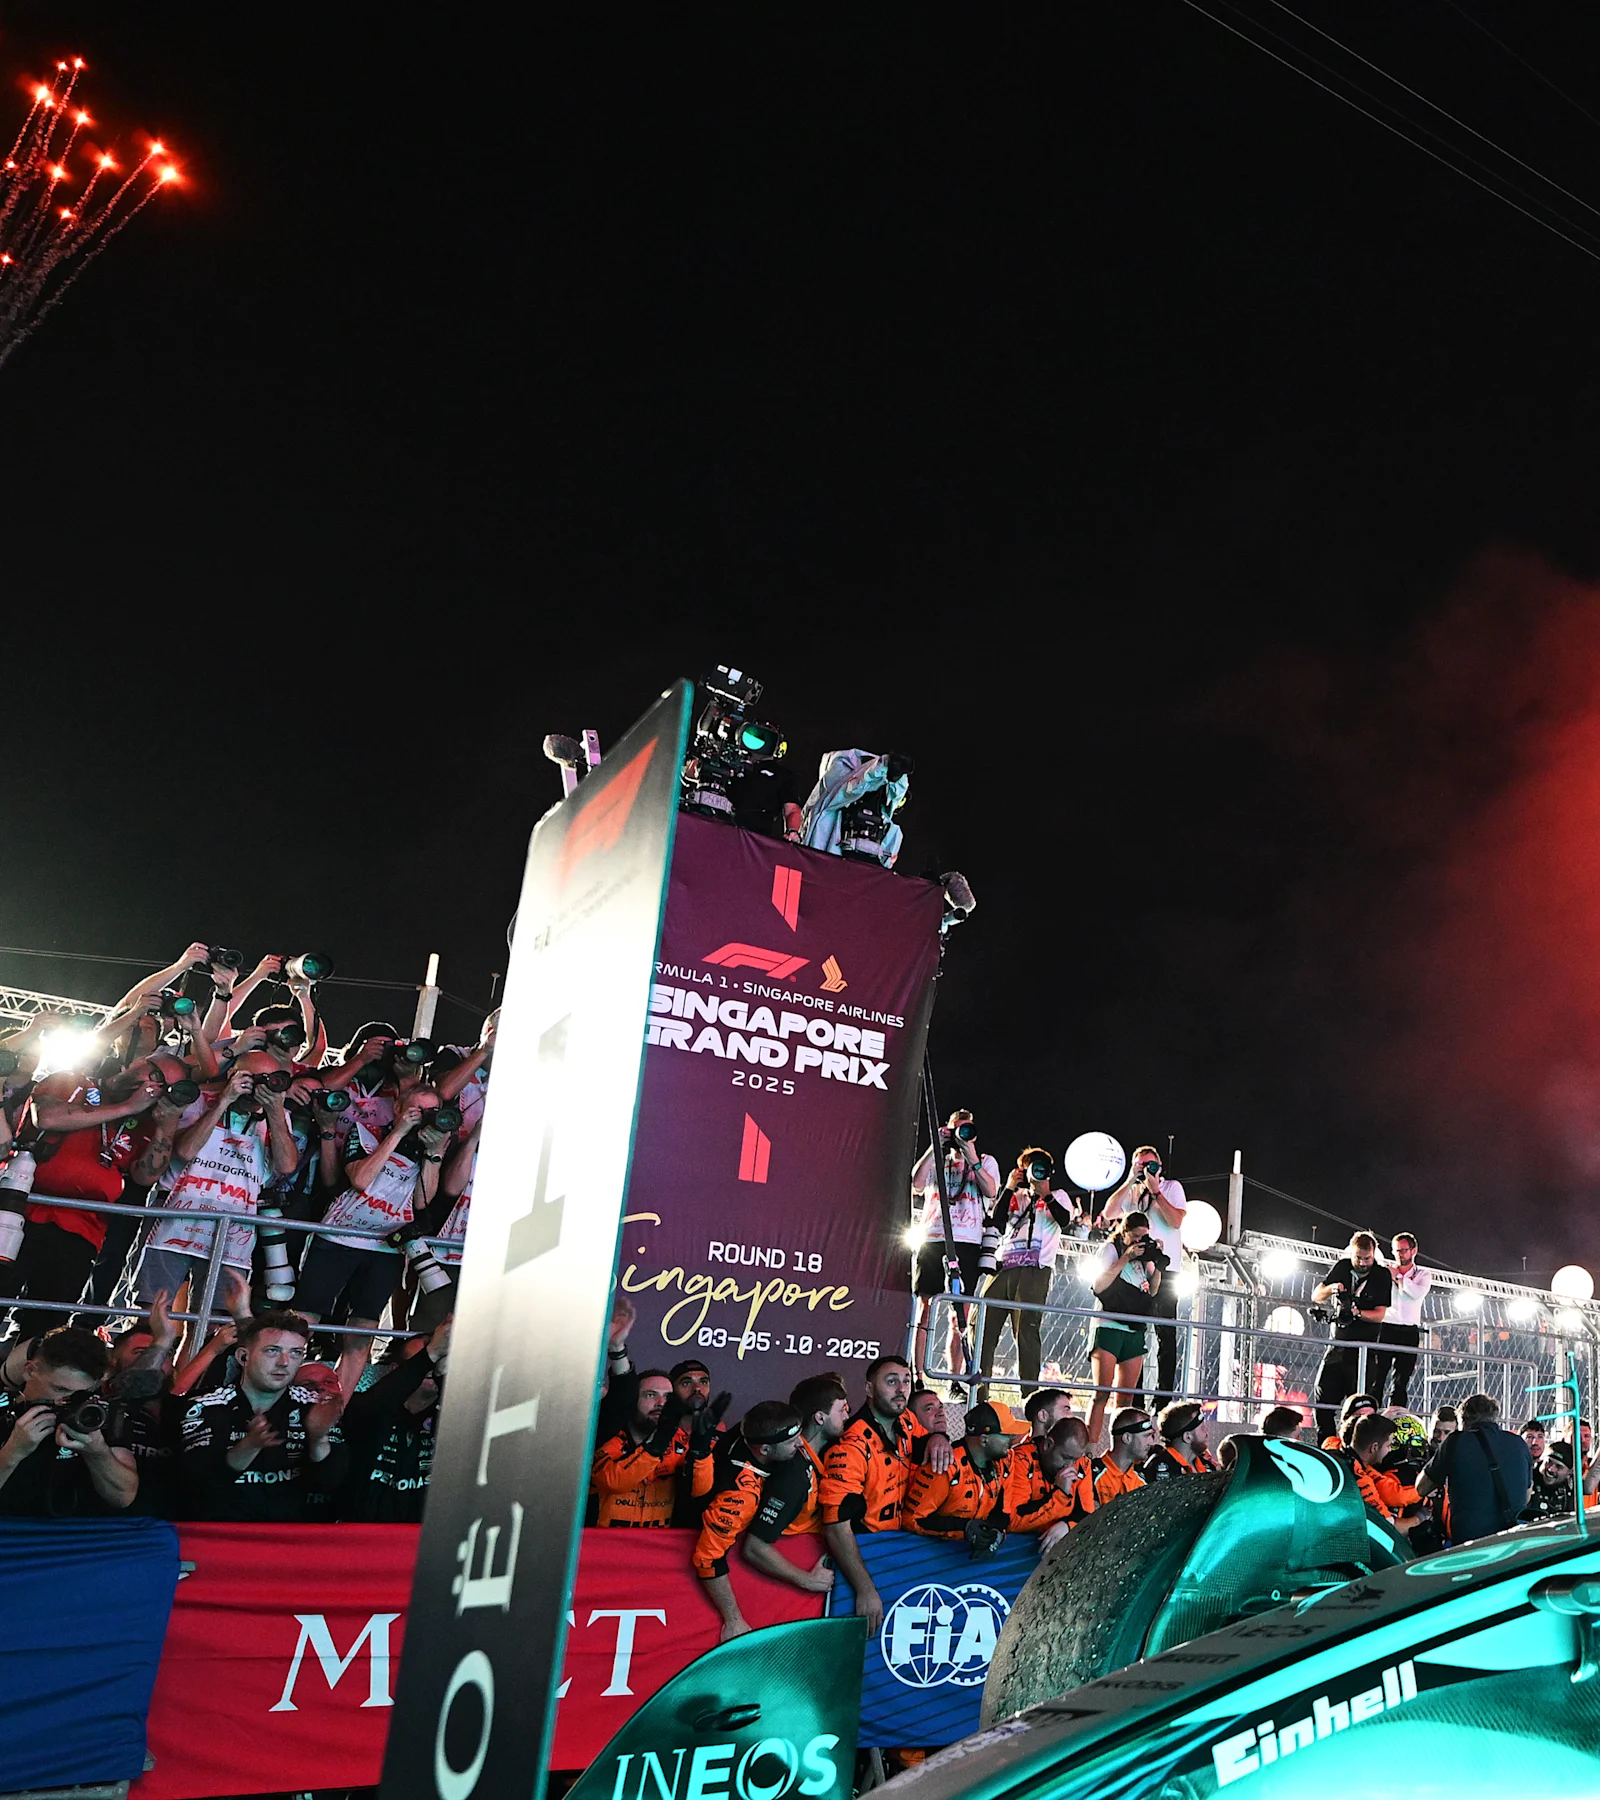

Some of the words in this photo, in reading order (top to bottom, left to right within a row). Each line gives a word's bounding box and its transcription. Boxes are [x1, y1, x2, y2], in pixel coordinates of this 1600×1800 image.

[654, 961, 713, 985] RMULA
[719, 975, 728, 989] 1
[742, 981, 834, 1013] SINGAPORE
[836, 1003, 905, 1028] AIRLINES
[648, 983, 886, 1059] SINGAPORE
[731, 1070, 796, 1096] 2025
[794, 1045, 891, 1091] PRIX
[193, 1157, 260, 1184] PHOTOGRAPH
[707, 1240, 787, 1270] ROUND
[792, 1250, 823, 1274] 18
[762, 1507, 779, 1519] okta
[1212, 1659, 1418, 1789] Einhell
[611, 1733, 841, 1800] INEOS
